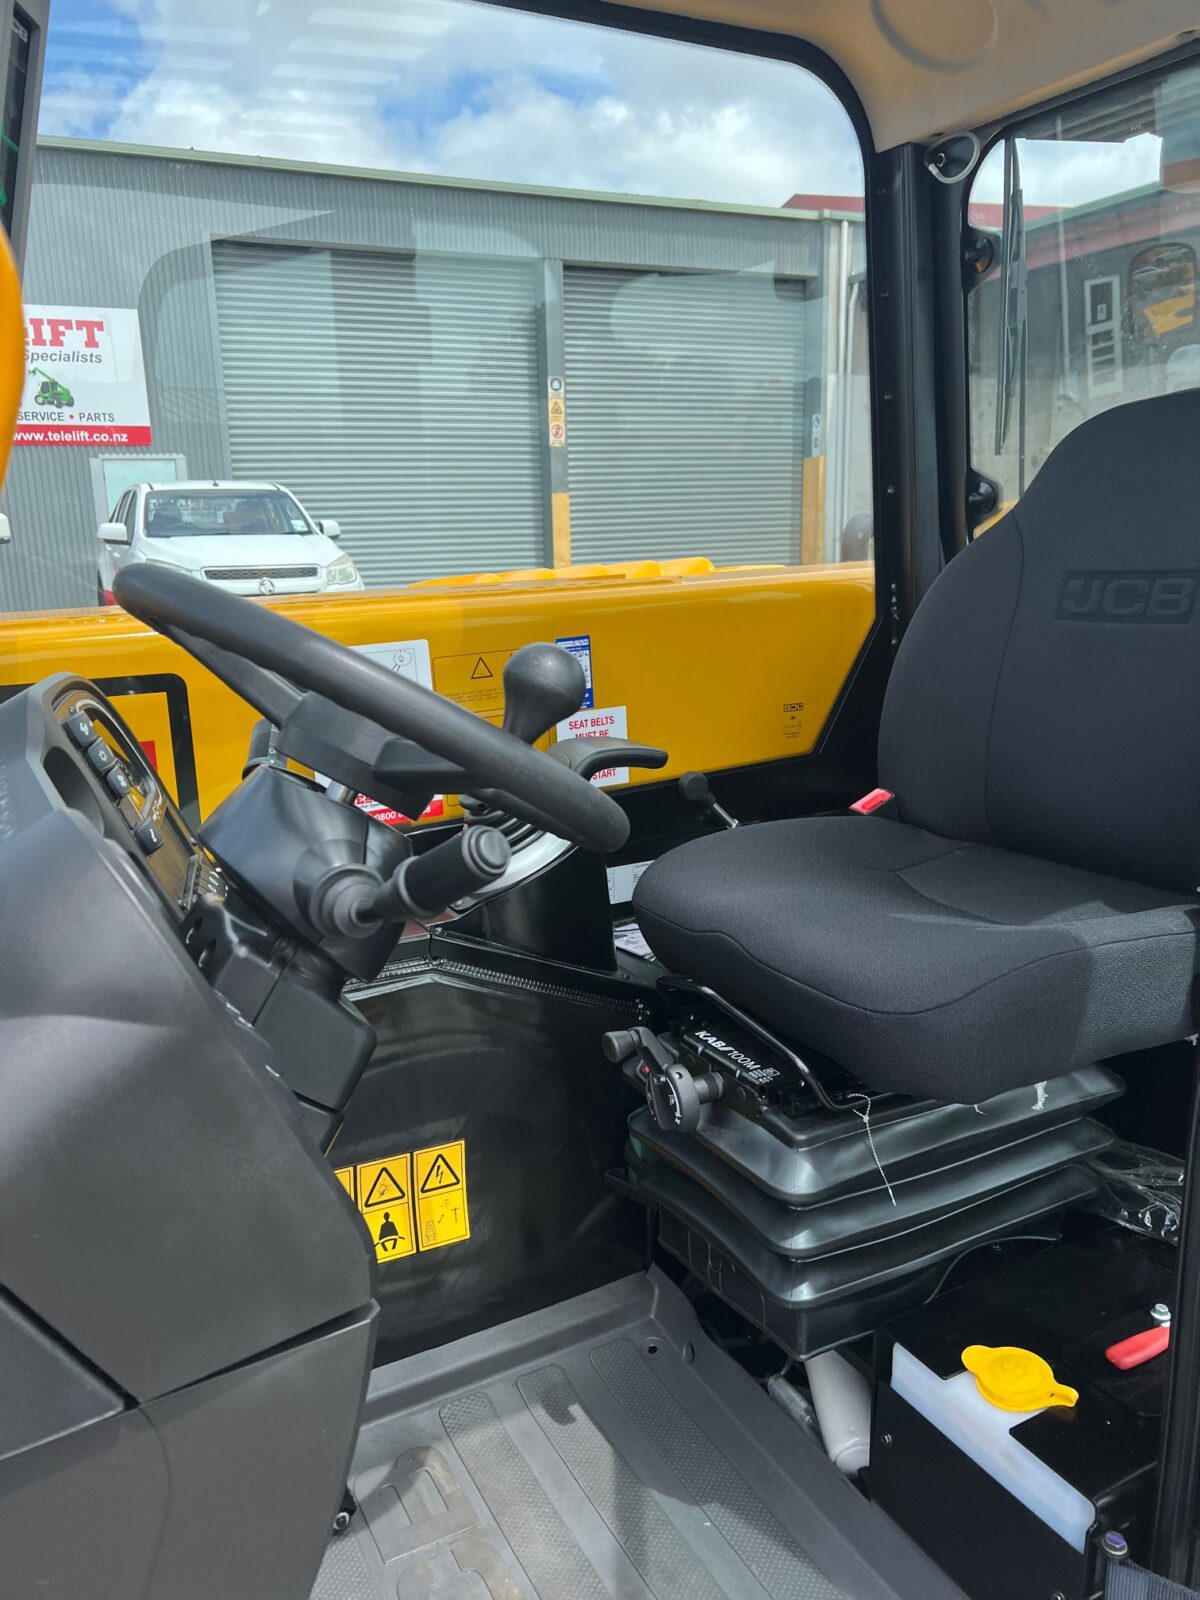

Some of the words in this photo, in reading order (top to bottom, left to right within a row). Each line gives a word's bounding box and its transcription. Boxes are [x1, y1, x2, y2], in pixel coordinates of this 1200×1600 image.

[24, 317, 104, 348] IFT
[24, 350, 102, 364] Specialists
[18, 411, 65, 422] SERVICE
[79, 412, 115, 422] PARTS
[12, 430, 129, 442] www.telelift.co.nz
[1062, 577, 1194, 617] JCB
[568, 719, 588, 730] SEAT
[590, 715, 615, 728] BELTS
[592, 768, 617, 780] START
[374, 810, 396, 821] 0800
